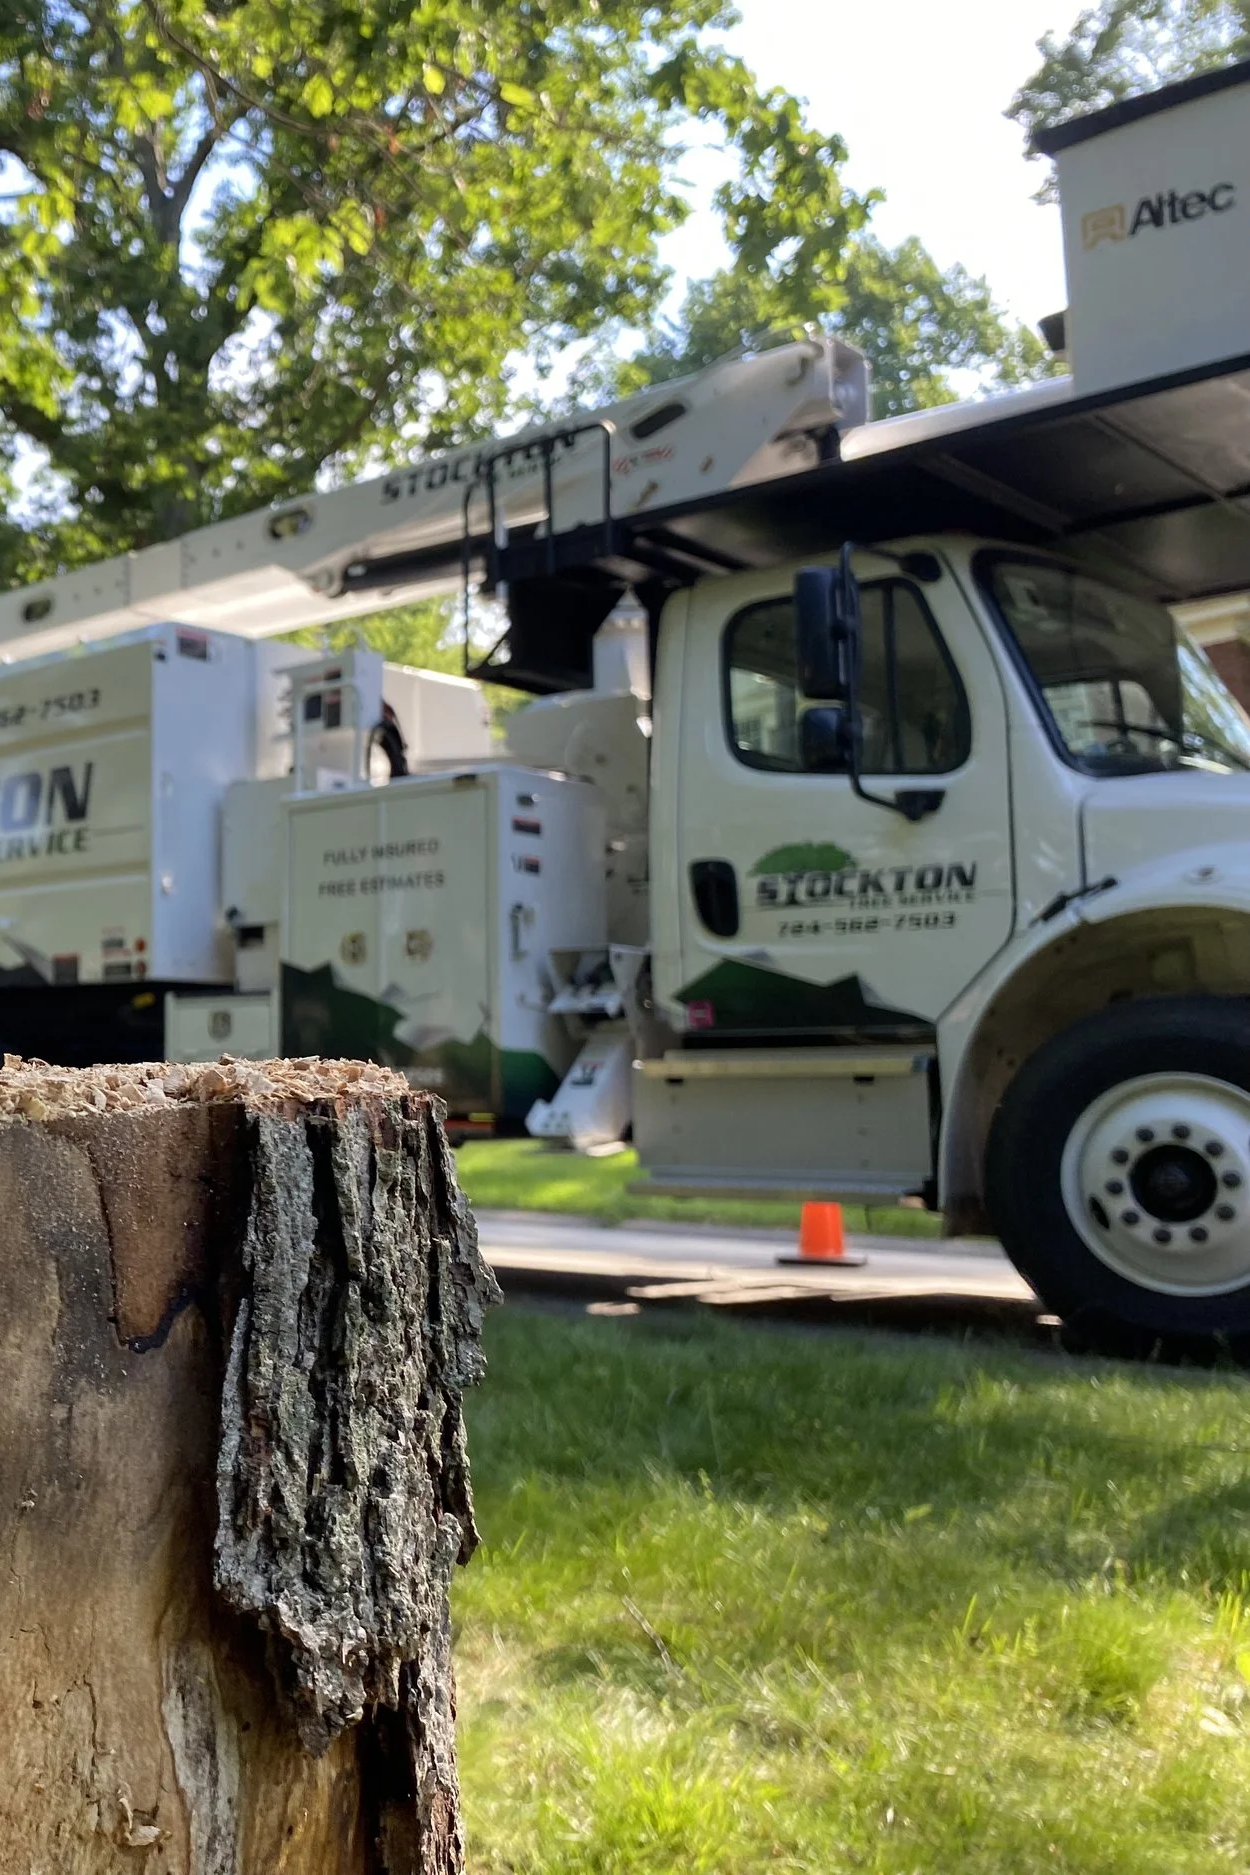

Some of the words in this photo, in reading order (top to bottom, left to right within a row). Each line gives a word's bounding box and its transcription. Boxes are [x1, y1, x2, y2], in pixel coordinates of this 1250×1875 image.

[1128, 181, 1236, 237] Altec
[322, 845, 367, 867] FULLY
[371, 837, 439, 860] INSURED
[317, 877, 357, 898] FREE
[359, 870, 445, 895] ESTIMATES
[756, 862, 977, 905] STOCKTON
